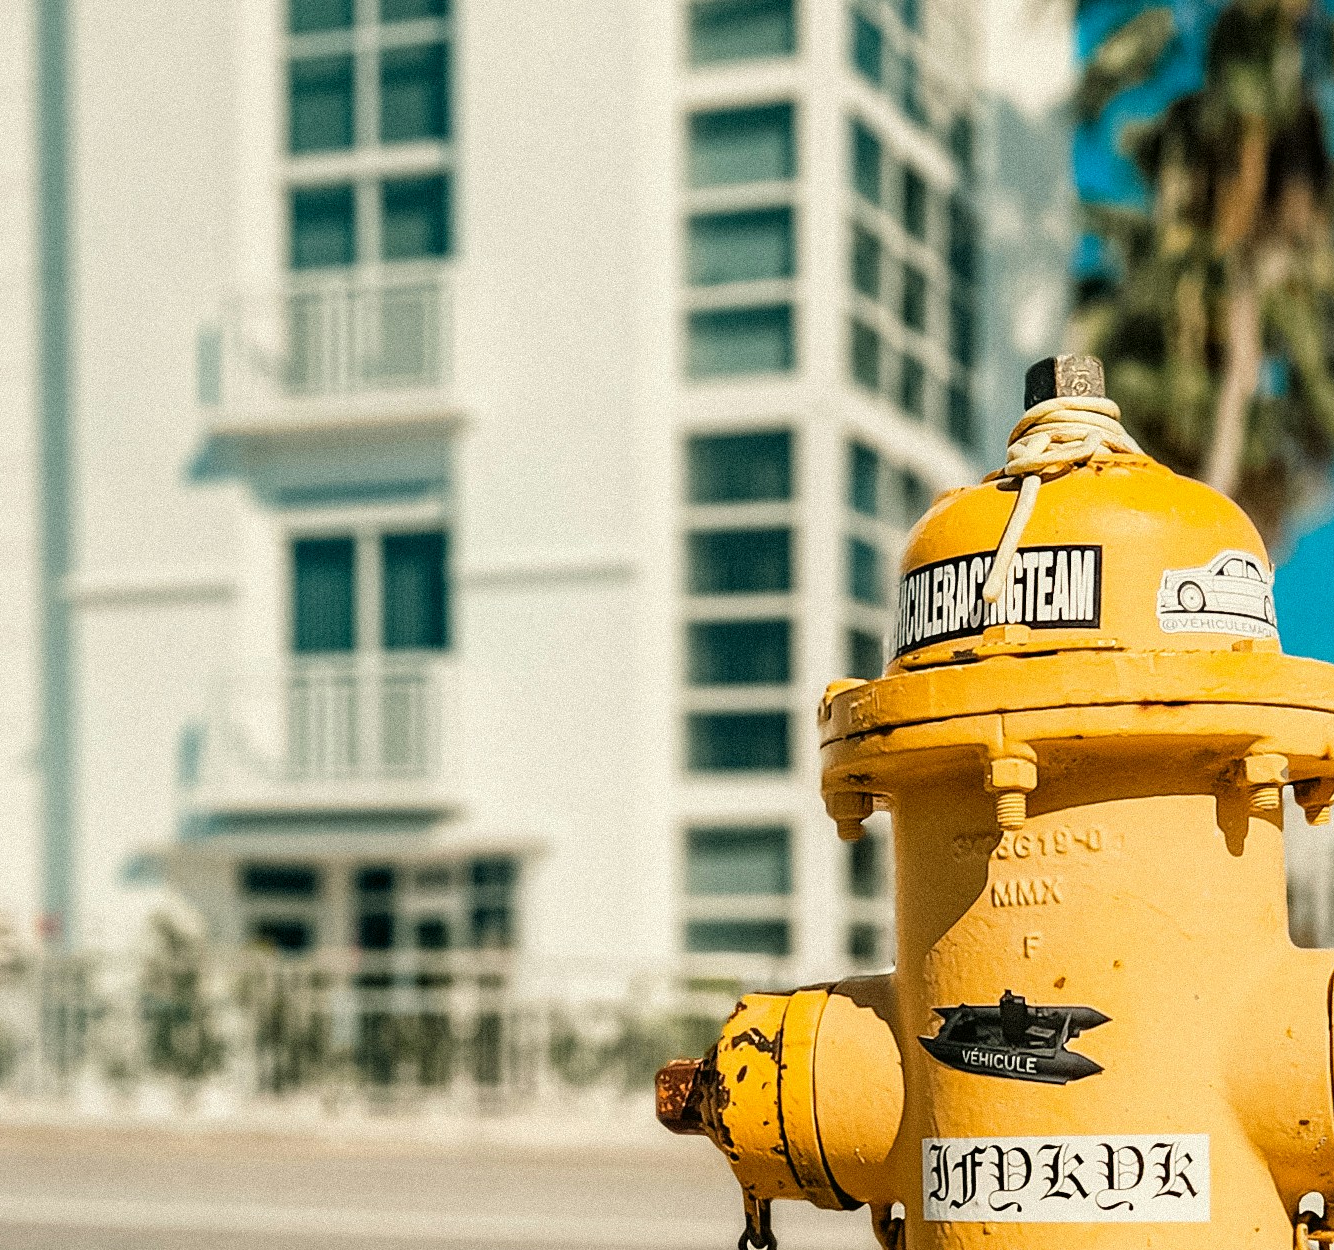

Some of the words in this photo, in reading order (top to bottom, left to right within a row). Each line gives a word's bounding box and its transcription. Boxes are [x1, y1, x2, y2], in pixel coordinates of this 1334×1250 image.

[990, 877, 1063, 908] MMX
[1022, 931, 1043, 959] F
[961, 1047, 1038, 1074] VÉHICULE
